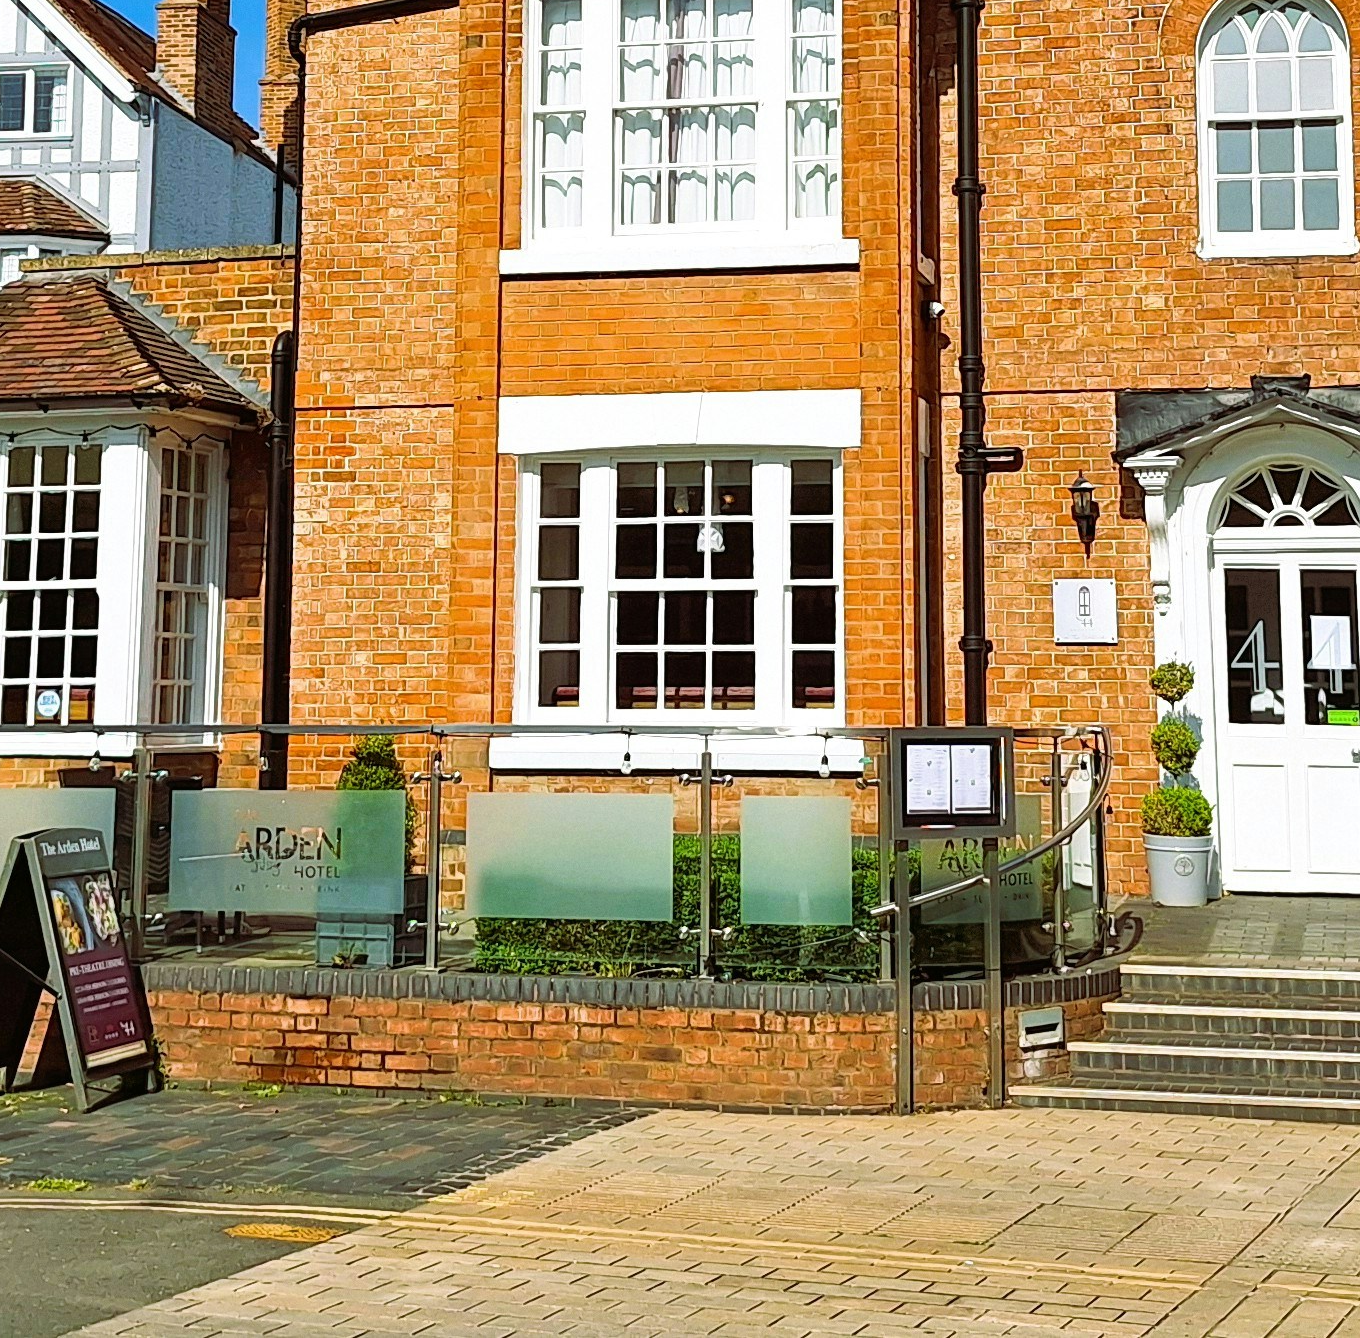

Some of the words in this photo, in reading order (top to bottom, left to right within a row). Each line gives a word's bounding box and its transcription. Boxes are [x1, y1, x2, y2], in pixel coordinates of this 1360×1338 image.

[40, 842, 56, 856] The
[57, 840, 80, 854] Arden
[79, 837, 101, 852] Hotel
[235, 827, 342, 861] ARDEN
[294, 866, 341, 879] HOTEL
[999, 872, 1033, 887] HOTEL
